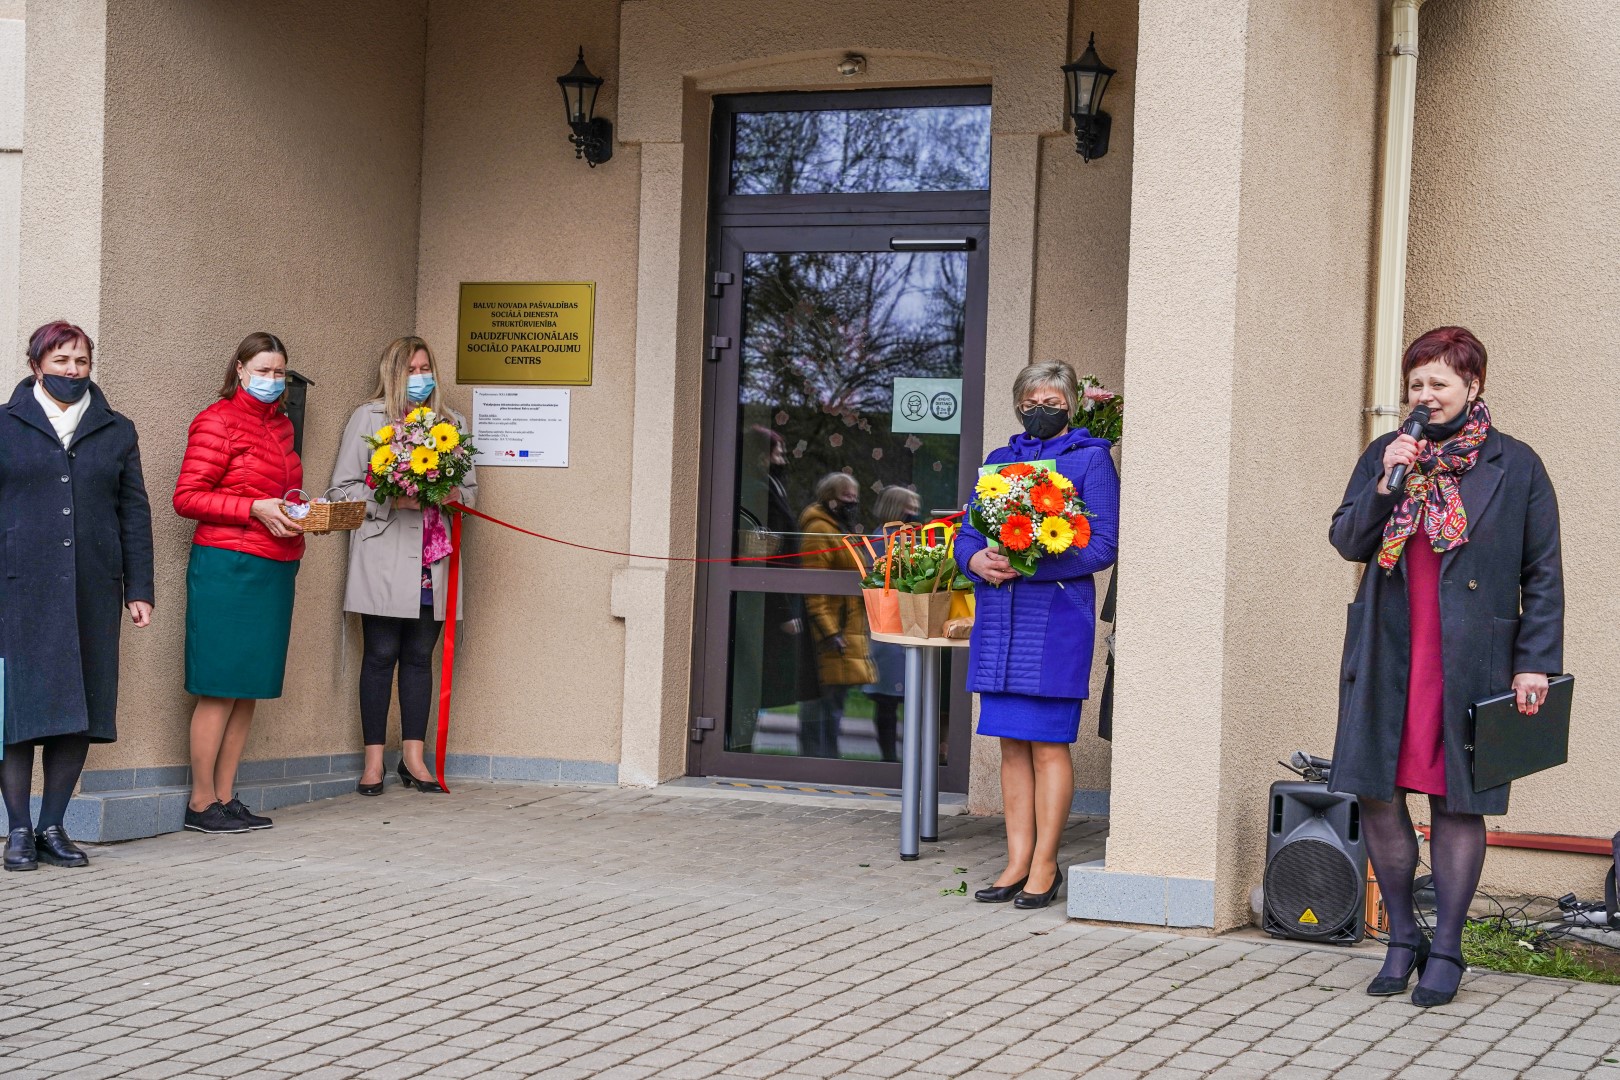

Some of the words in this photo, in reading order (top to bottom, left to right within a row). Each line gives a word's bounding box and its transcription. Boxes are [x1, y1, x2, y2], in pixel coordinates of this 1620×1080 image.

[529, 301, 579, 309] PAŠVALDĪBAS
[490, 310, 522, 318] SOCIĀLĀ
[491, 320, 557, 328] STRUKTŪRVIENĪBA
[470, 331, 579, 341] DAUDZFUNKCIONĀLAIS
[467, 342, 509, 353] SOCIĀLO
[511, 344, 581, 353] PAKALPOJUMU
[504, 356, 542, 365] CENTRS
